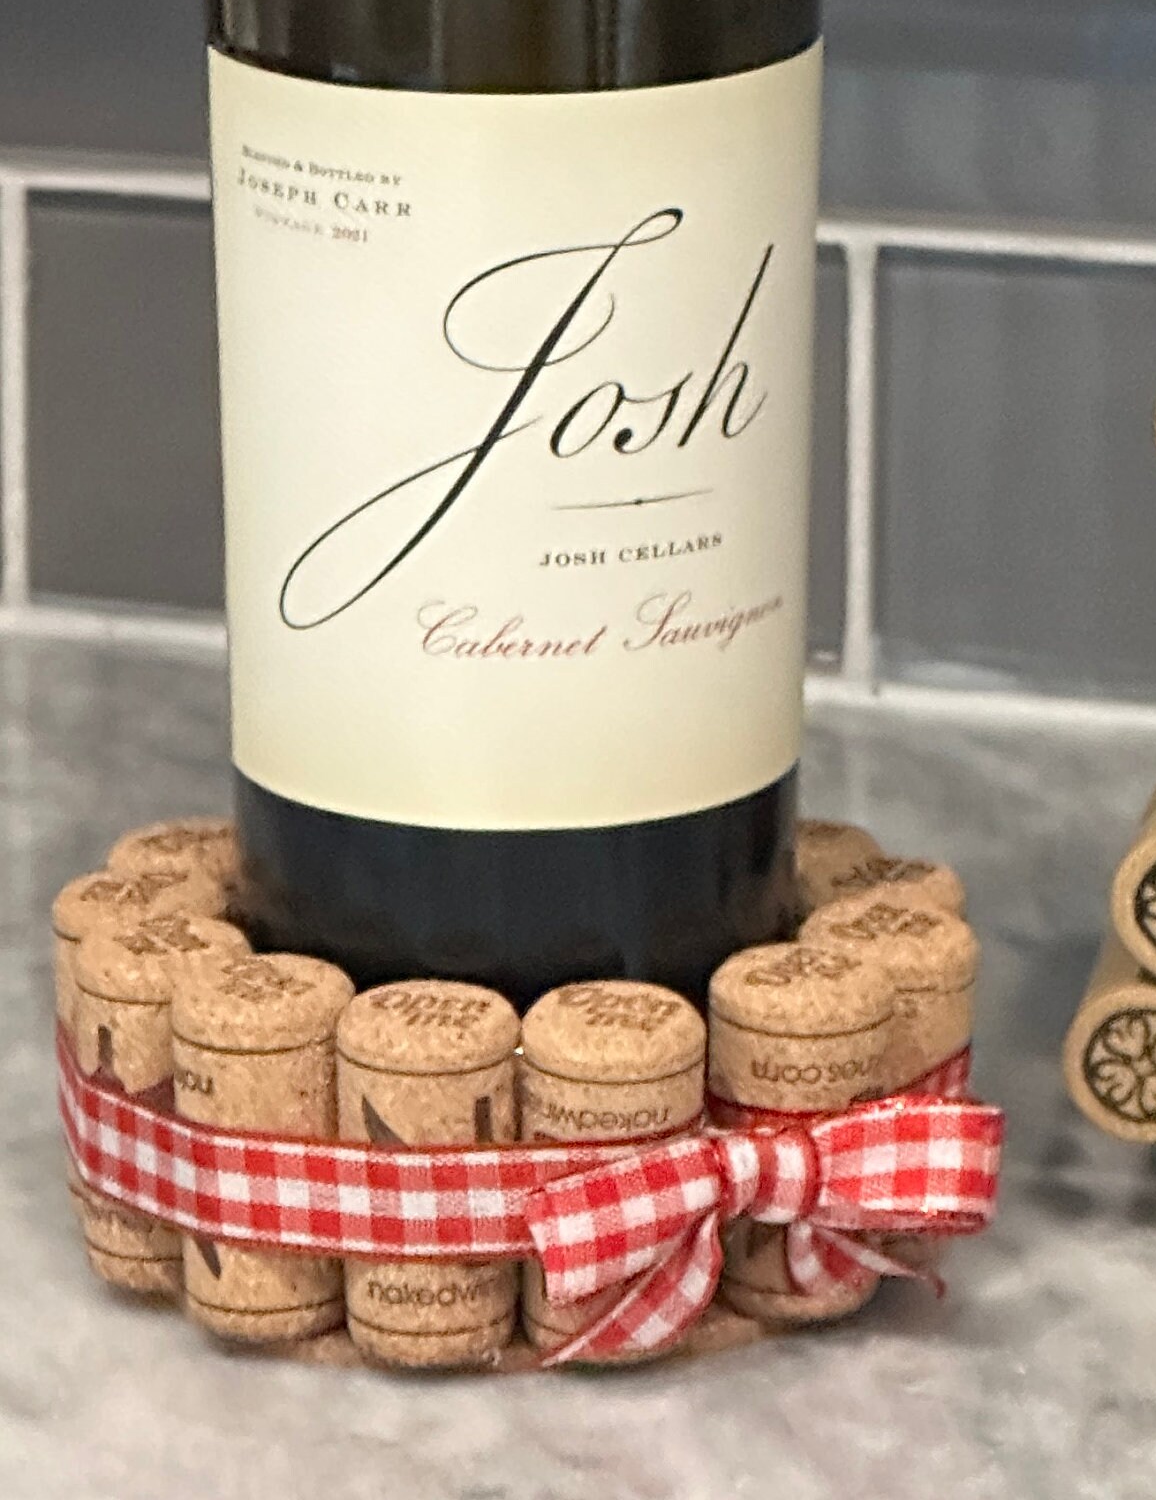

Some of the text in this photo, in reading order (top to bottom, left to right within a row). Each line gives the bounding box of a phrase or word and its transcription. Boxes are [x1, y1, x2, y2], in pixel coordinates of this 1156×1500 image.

[236, 165, 412, 218] JOSEPH CARR
[279, 206, 775, 631] Josh
[538, 532, 724, 568] JOSH CELLARS
[416, 599, 609, 659] Cabernet
